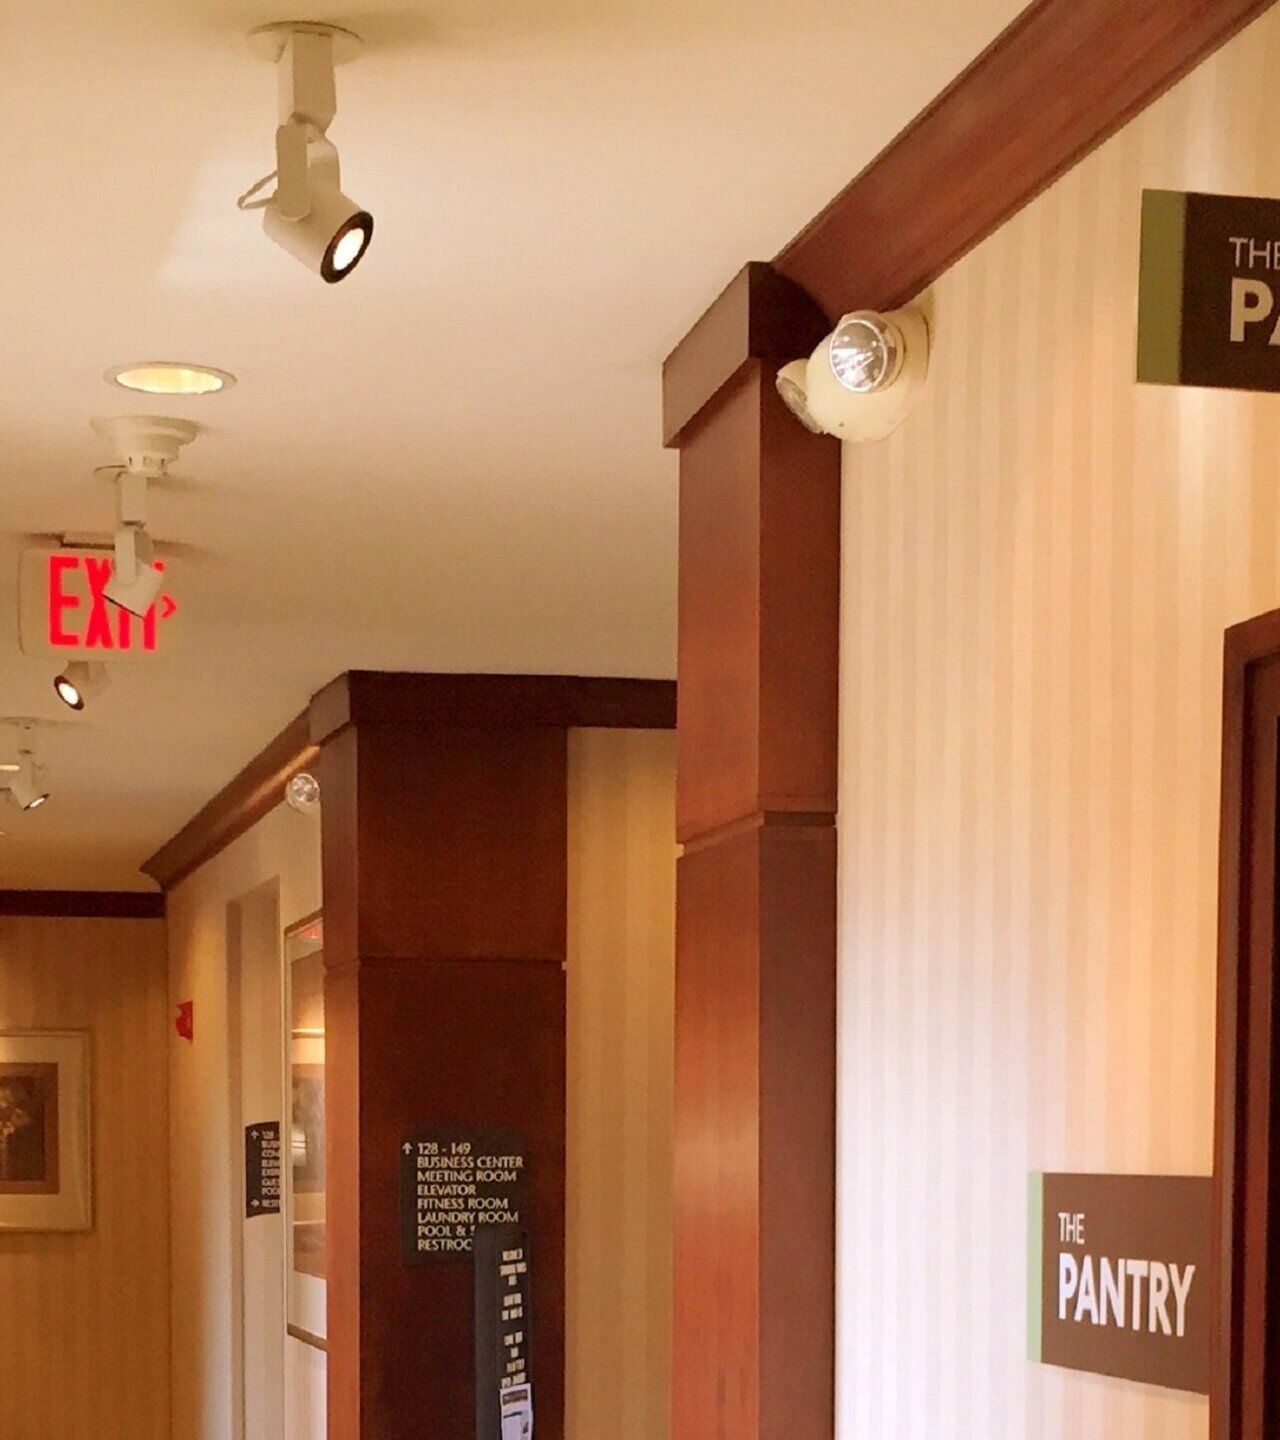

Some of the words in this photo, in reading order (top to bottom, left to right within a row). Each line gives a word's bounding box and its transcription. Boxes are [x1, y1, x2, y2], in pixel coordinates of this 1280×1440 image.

[417, 1142, 439, 1155] 128
[451, 1142, 472, 1155] 149
[417, 1156, 475, 1169] BUSINESS
[476, 1156, 524, 1169] CENTER
[417, 1169, 474, 1182] MEETING
[476, 1170, 517, 1182] ROOM
[417, 1184, 476, 1196] ELEVATOR
[417, 1198, 465, 1210] FITNESS
[467, 1198, 509, 1210] ROOM
[417, 1211, 476, 1224] LAUNDRY
[478, 1211, 519, 1223] ROOM
[417, 1225, 452, 1237] POOL
[456, 1224, 466, 1237] &
[1057, 1211, 1086, 1245] THE
[1058, 1252, 1197, 1338] PANTRY
